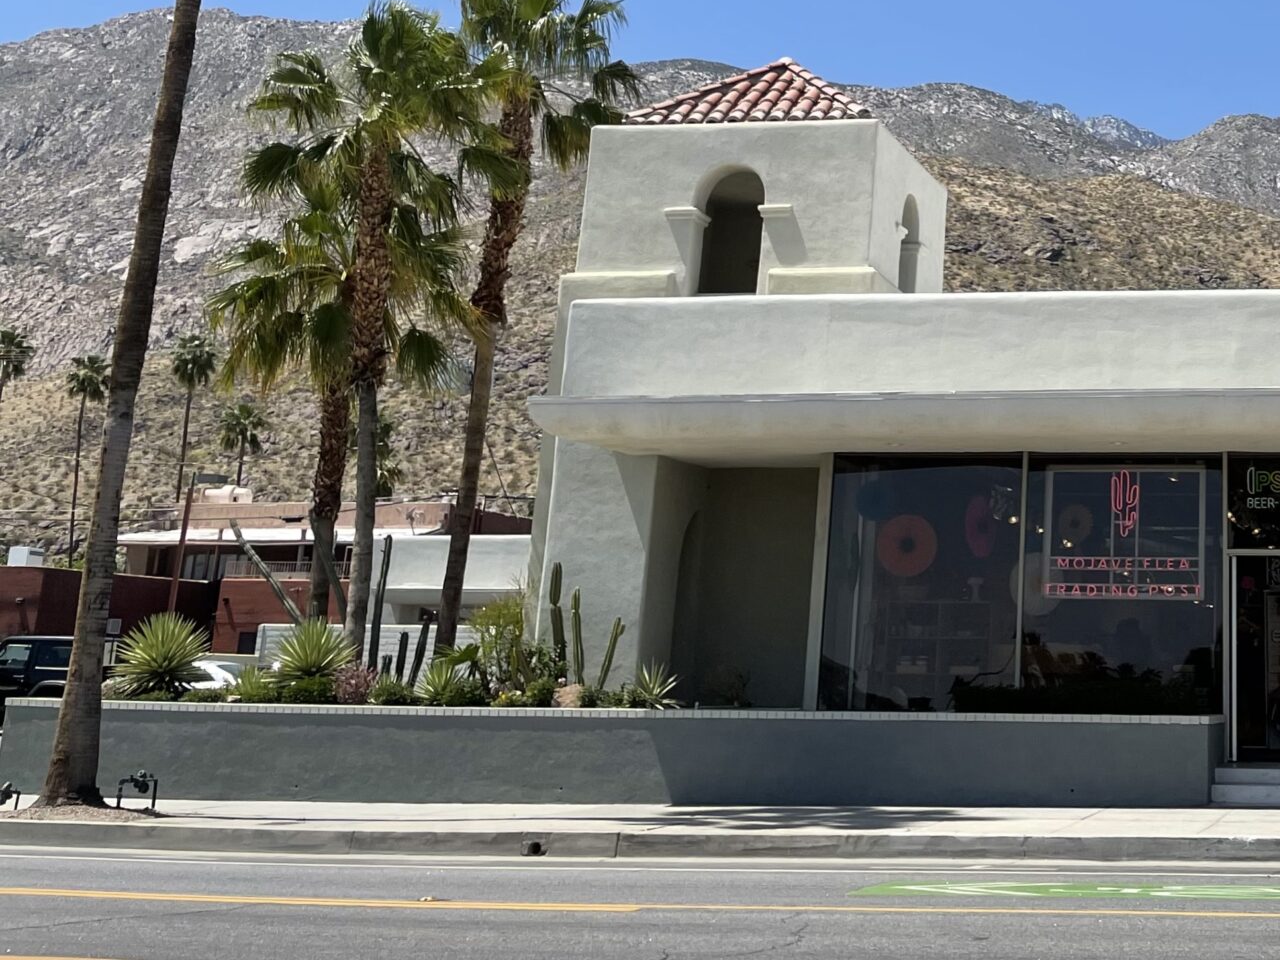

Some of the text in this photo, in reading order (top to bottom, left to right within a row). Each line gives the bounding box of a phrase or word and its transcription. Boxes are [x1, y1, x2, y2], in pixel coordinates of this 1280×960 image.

[1057, 557, 1190, 570] MOJAVE FLEA
[1044, 584, 1200, 597] TRADING POST
